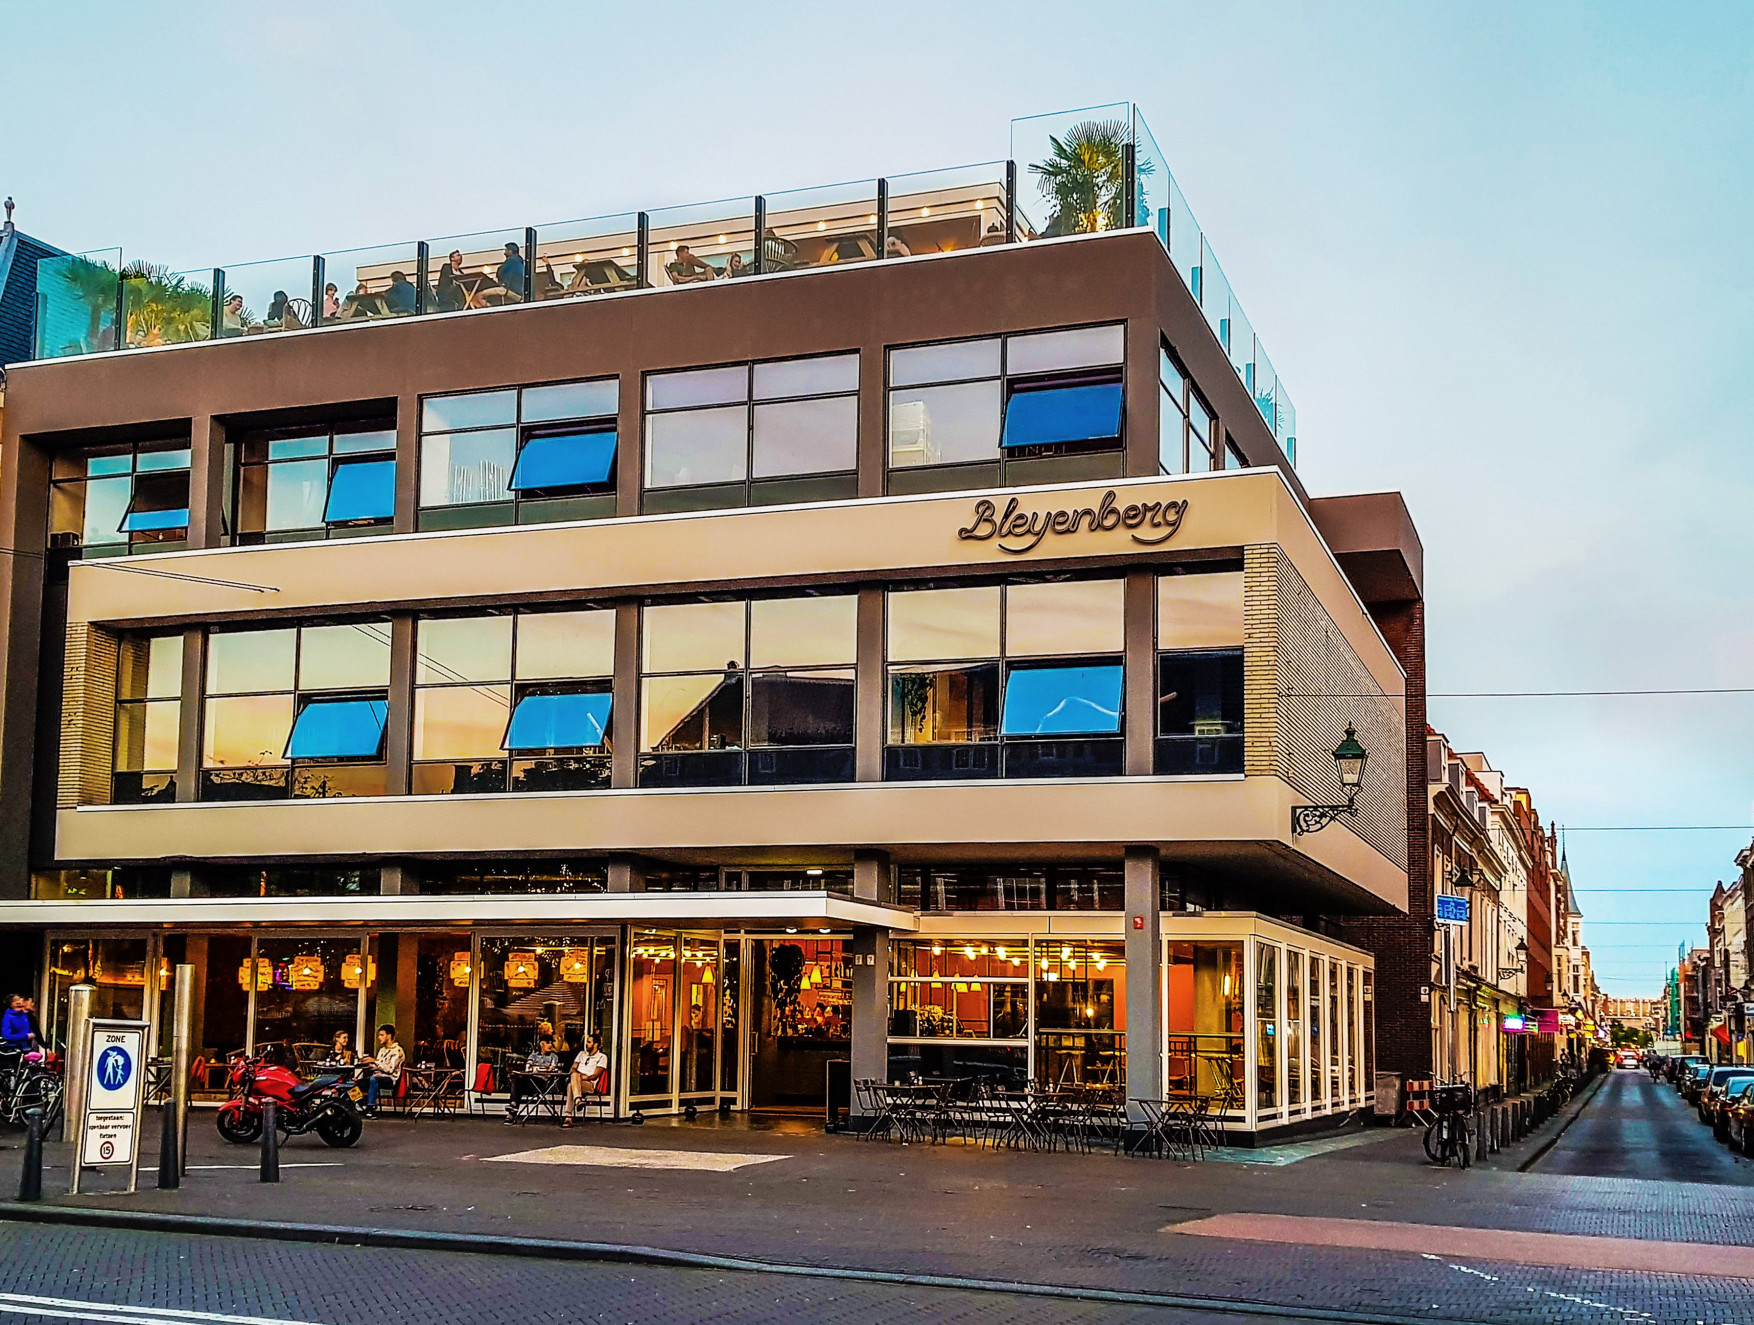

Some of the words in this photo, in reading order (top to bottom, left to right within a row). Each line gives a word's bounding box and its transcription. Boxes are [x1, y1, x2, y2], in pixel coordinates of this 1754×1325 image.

[958, 491, 1188, 554] Bleyenberg
[106, 1035, 126, 1043] ZONE
[103, 1146, 111, 1155] 15
